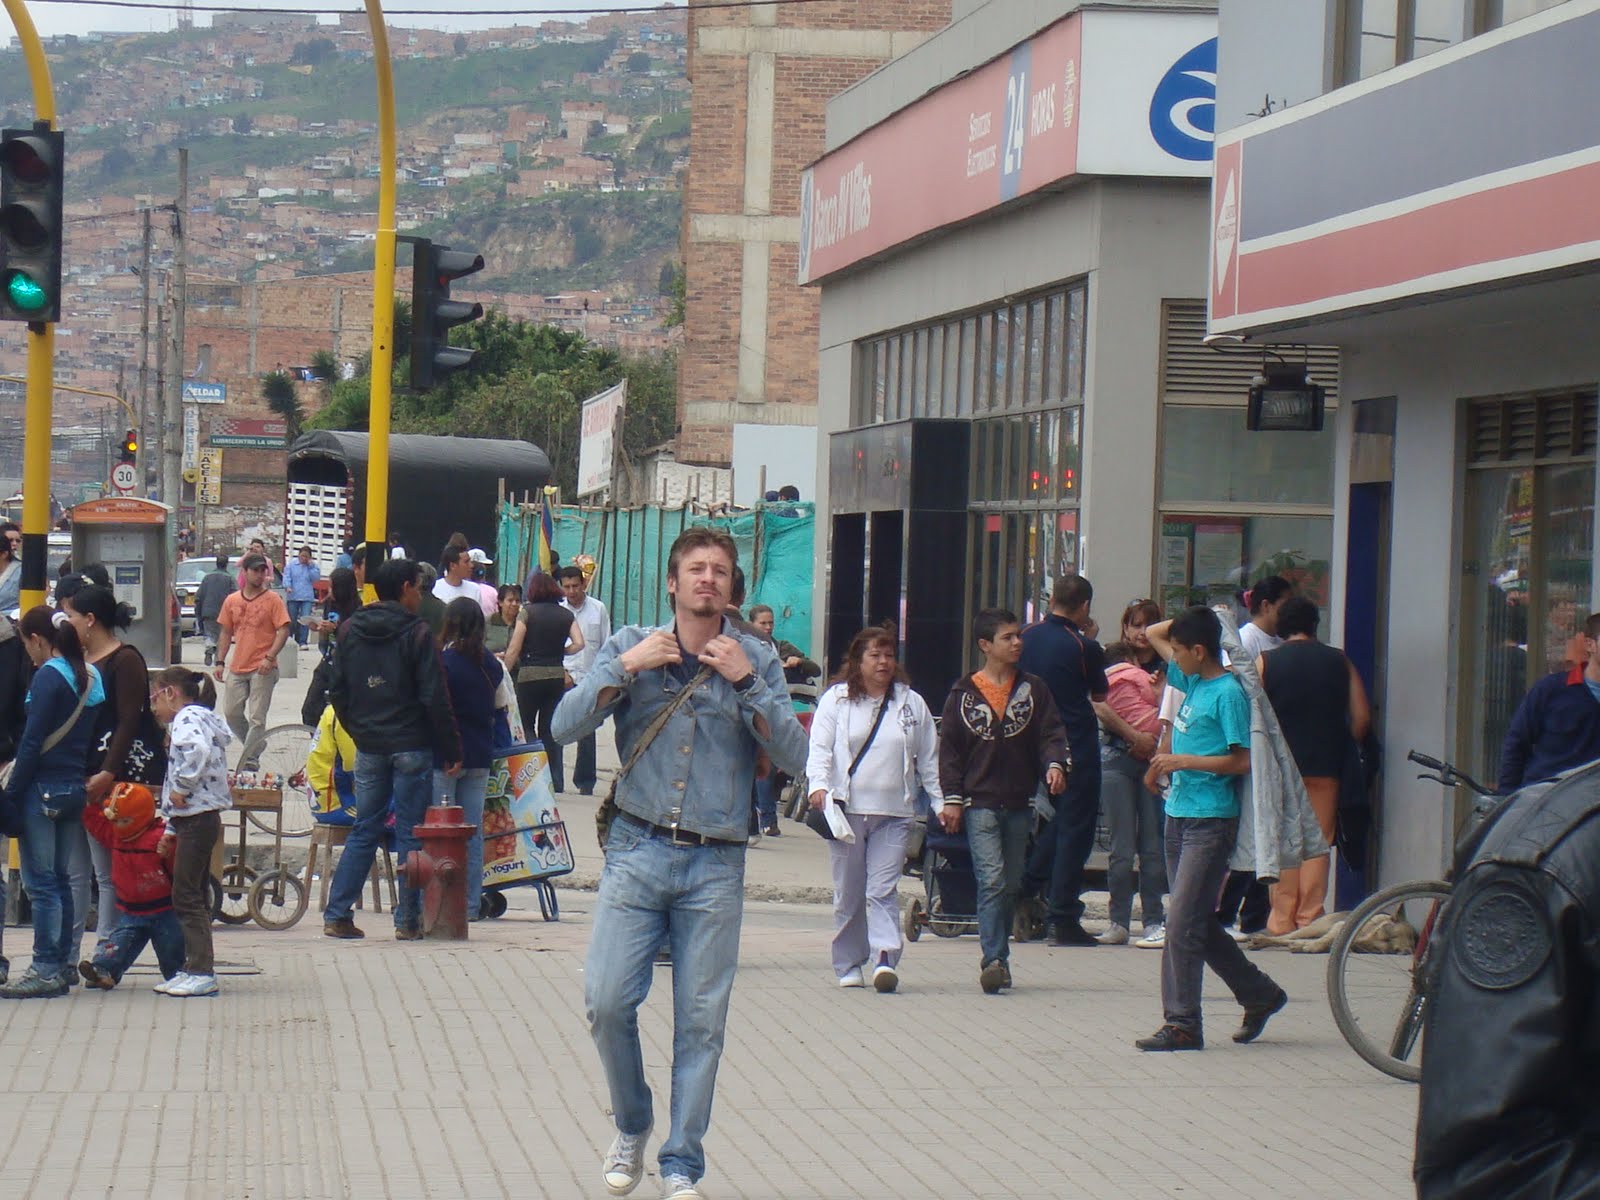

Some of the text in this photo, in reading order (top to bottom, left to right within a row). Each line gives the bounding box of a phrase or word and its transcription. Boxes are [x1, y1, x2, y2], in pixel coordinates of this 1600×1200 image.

[1004, 71, 1025, 176] 24
[1031, 82, 1056, 137] HORAS
[814, 188, 838, 251] Banco
[118, 471, 132, 482] 30
[201, 456, 211, 503] ACEITES
[491, 860, 525, 874] Yogurt
